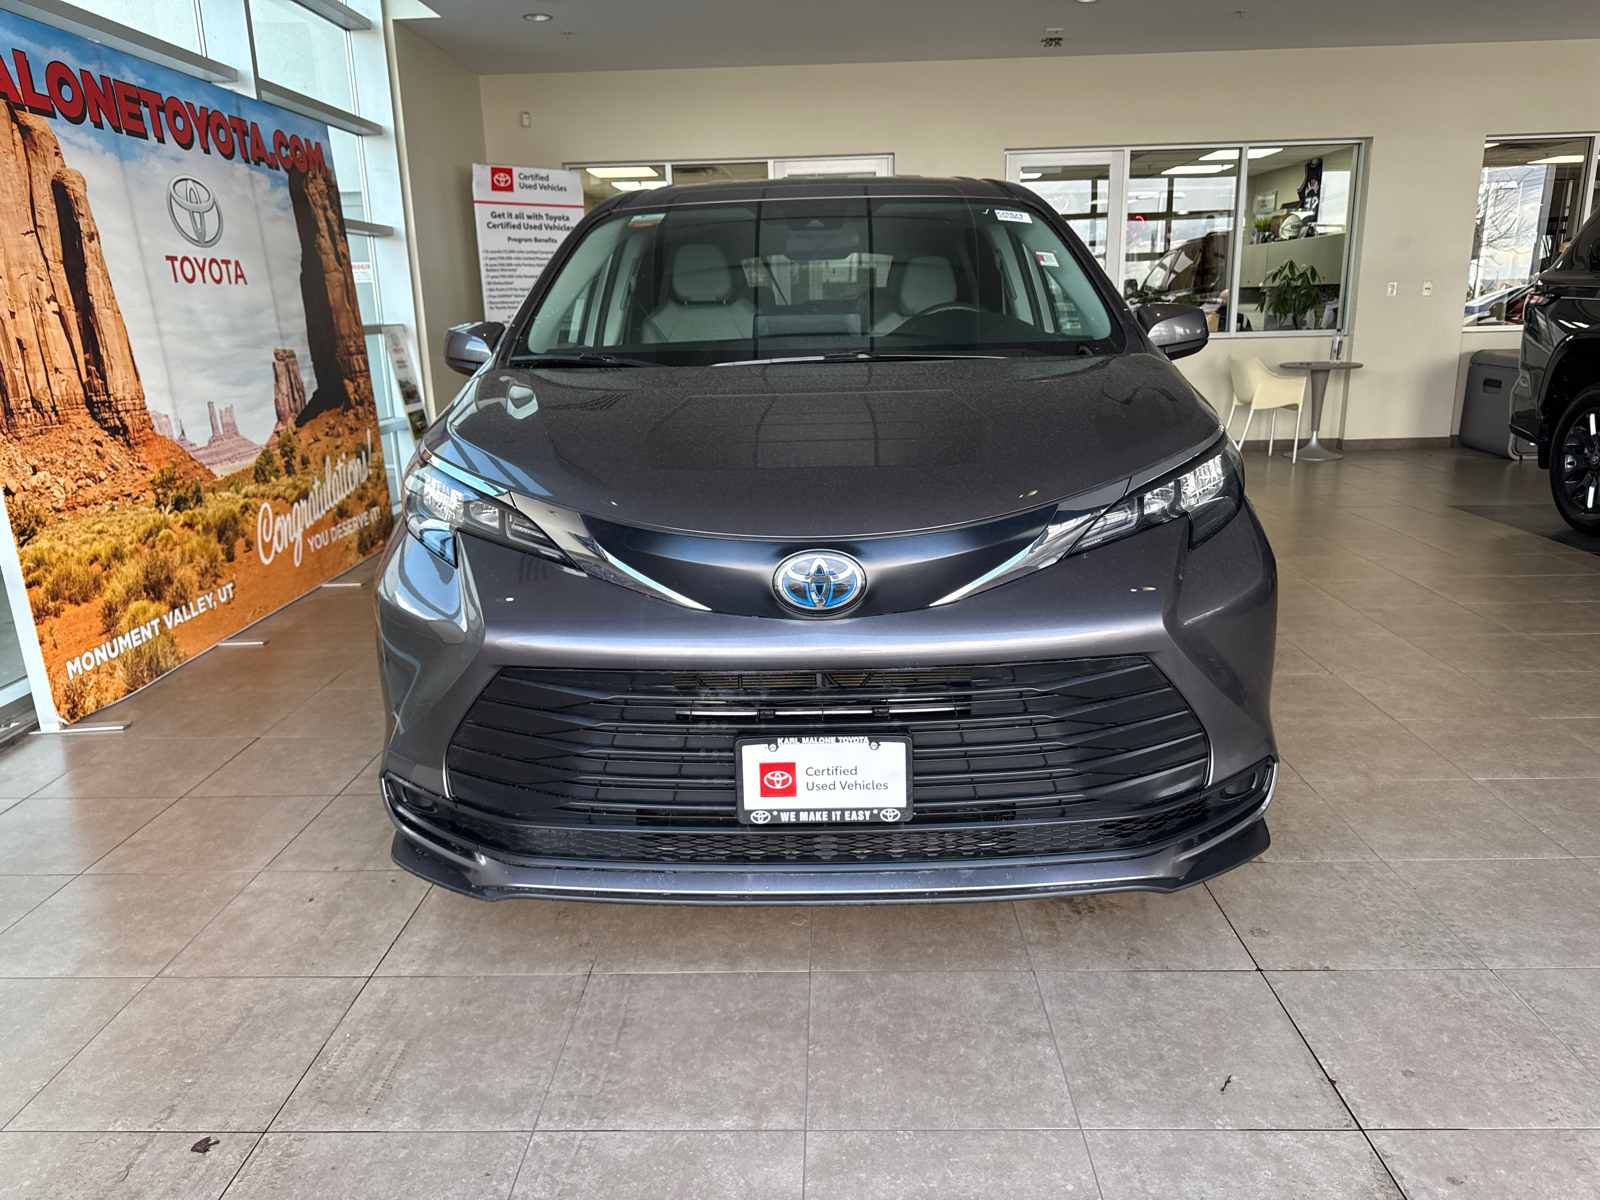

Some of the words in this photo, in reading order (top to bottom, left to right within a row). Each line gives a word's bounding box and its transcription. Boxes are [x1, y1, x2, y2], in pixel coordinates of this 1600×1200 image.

[518, 172, 550, 182] Certified
[518, 182, 538, 191] Used
[538, 182, 567, 192] Vehicles
[490, 211, 506, 220] Get
[507, 211, 513, 220] it
[515, 212, 525, 220] all
[526, 212, 544, 221] with
[545, 213, 571, 223] Toyota
[486, 221, 522, 230] Certified
[523, 222, 543, 231] Used
[507, 236, 534, 244] Program
[165, 255, 248, 286] TOYOTA
[307, 529, 329, 553] YOU
[330, 511, 369, 542] DESERVE
[65, 617, 161, 681] MONUMENT
[162, 591, 218, 631] VALLEY,
[216, 581, 235, 604] UT
[777, 737, 799, 746] KARL
[801, 736, 837, 745] MALONE
[837, 736, 870, 745] TOYOTA
[805, 766, 858, 777] Certified
[806, 781, 836, 791] Used
[839, 780, 889, 791] Vehicles
[780, 811, 796, 822] WE
[799, 811, 829, 821] MAKE
[832, 811, 842, 821] IT
[845, 810, 871, 821] EASY
